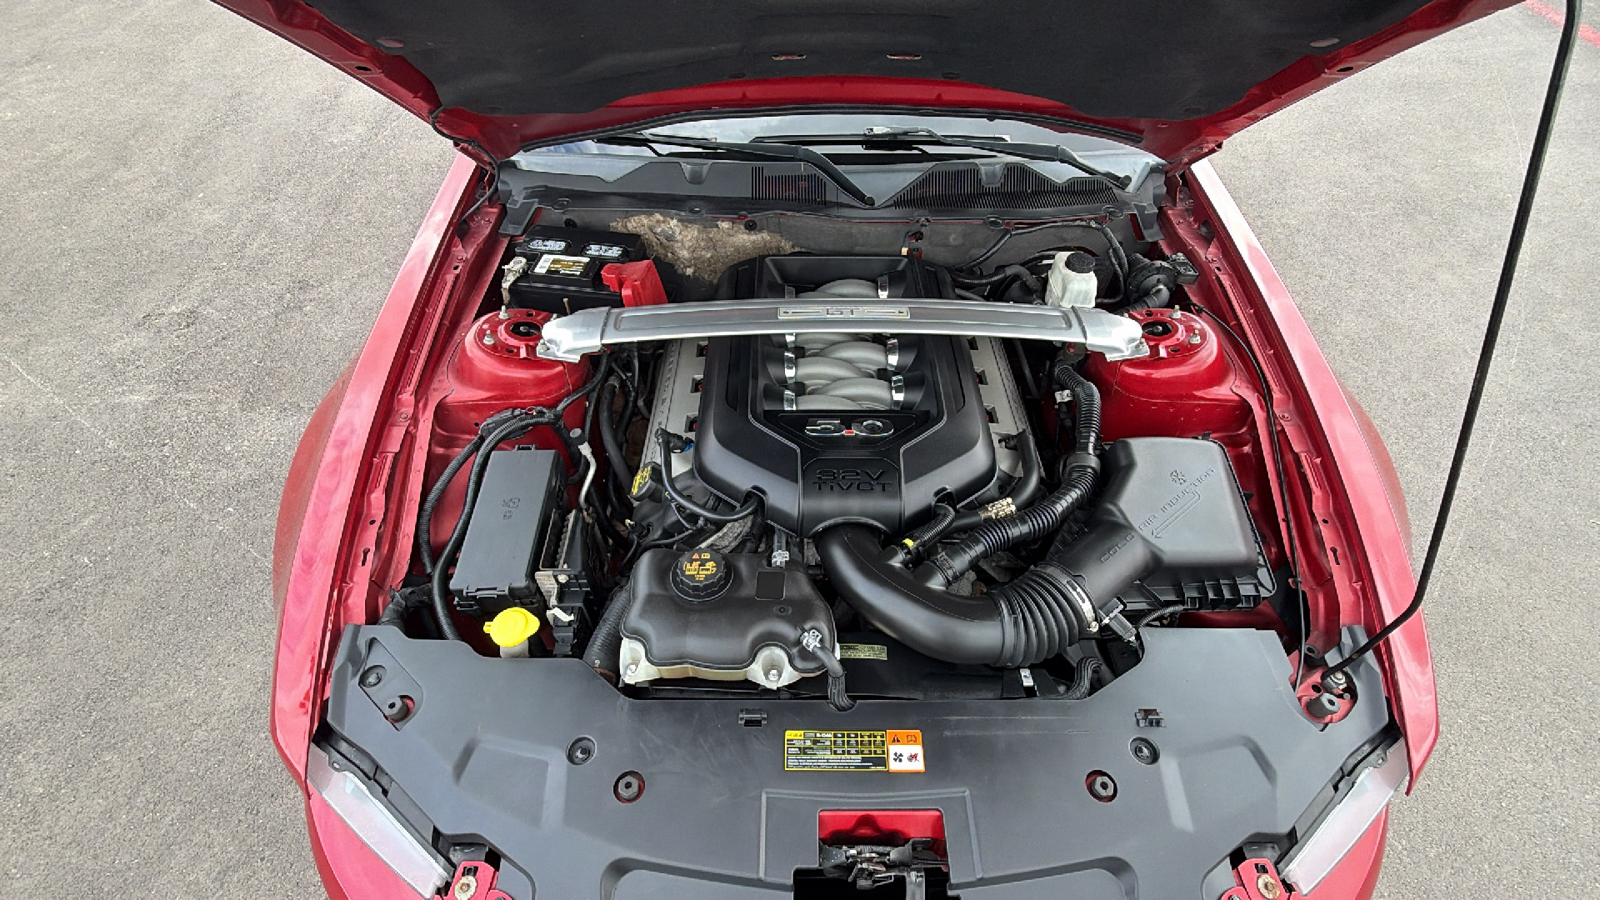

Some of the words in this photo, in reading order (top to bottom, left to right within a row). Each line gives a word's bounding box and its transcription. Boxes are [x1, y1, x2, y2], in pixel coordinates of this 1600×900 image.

[804, 418, 894, 436] 5.0
[816, 468, 886, 481] 32V
[1100, 533, 1134, 564] COLD
